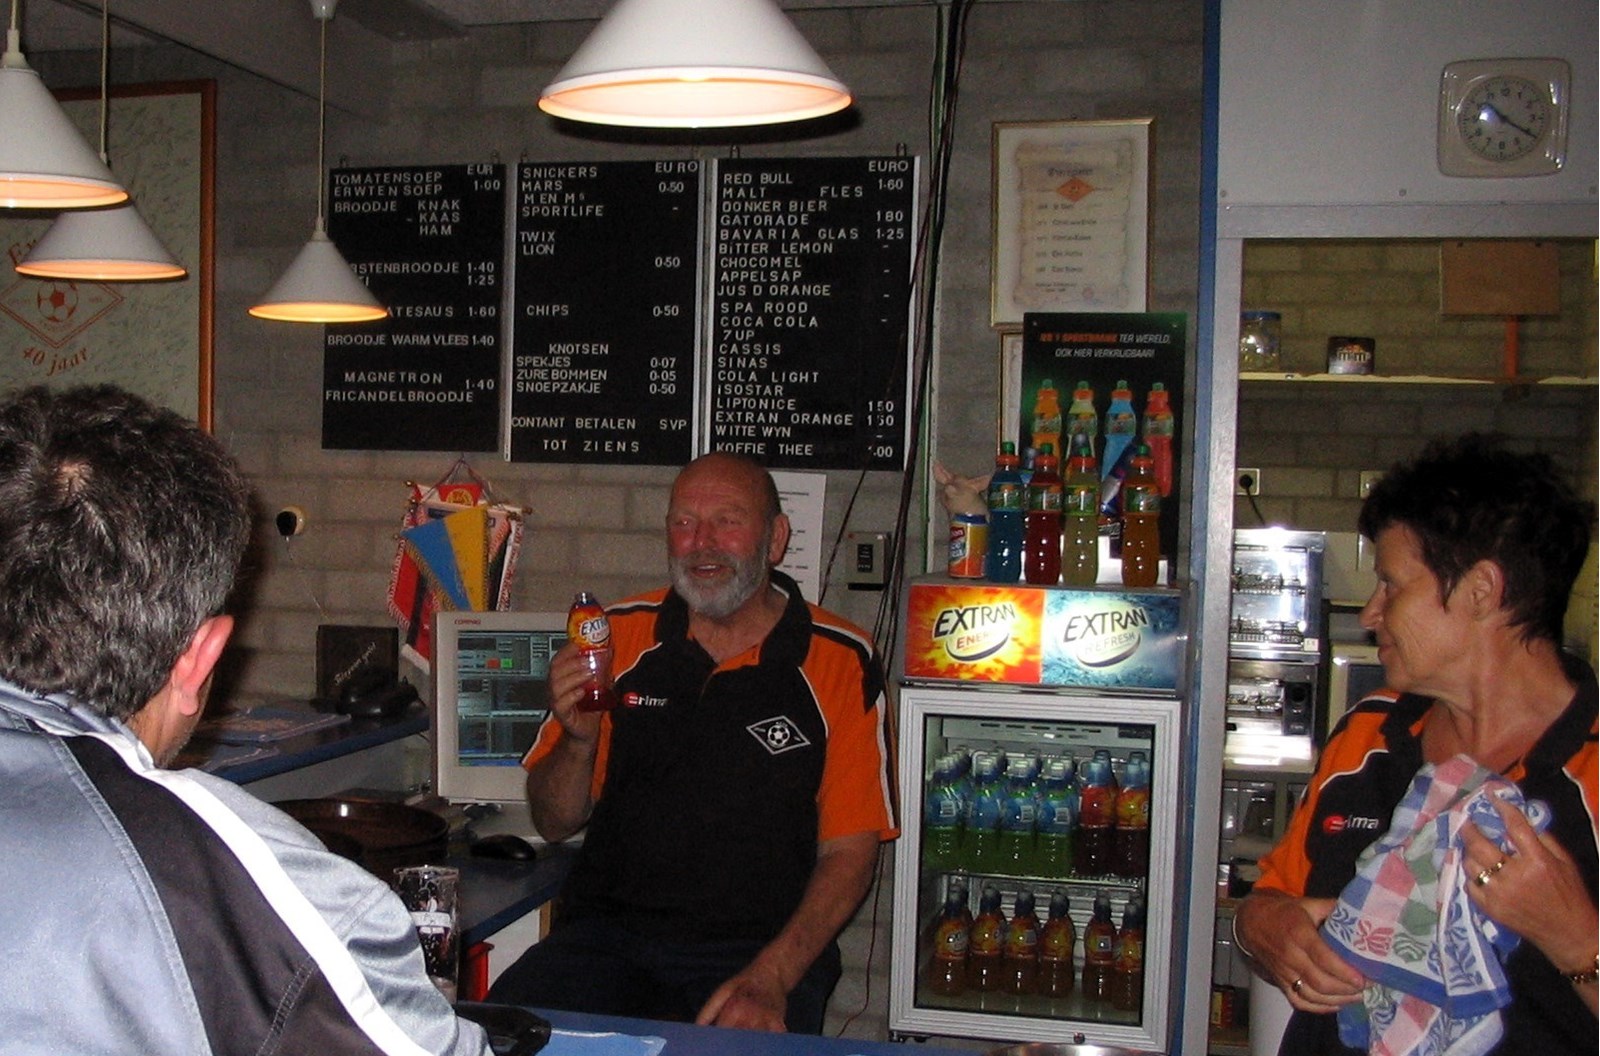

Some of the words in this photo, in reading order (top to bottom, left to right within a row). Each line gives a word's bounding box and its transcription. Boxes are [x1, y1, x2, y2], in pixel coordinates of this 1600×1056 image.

[467, 164, 493, 175] EUR
[655, 161, 698, 173] EURO
[868, 160, 909, 172] EURO
[334, 172, 442, 185] TOMATENSOEP
[523, 167, 597, 179] SNICKERS
[724, 173, 752, 184] RED
[760, 173, 793, 184] BULL
[522, 180, 563, 191] MARS
[723, 187, 766, 198] MALT
[820, 186, 863, 197] FLES
[334, 201, 397, 213] BROODJE
[417, 200, 460, 211] KNAK
[522, 205, 604, 217] SPORTLIFE
[722, 201, 781, 213] DONKER
[789, 200, 827, 212] BIER
[419, 212, 460, 223] KAAS
[720, 214, 809, 226] GATORADE
[419, 225, 452, 236] HAM
[520, 231, 555, 242] TWIX
[720, 228, 800, 240] BAVARIA
[818, 228, 859, 239] GLAS
[523, 244, 554, 255] LION
[781, 243, 833, 254] LEMON
[352, 262, 459, 274] RSTENBROODJE
[720, 257, 802, 268] CHOCOMEL
[720, 270, 801, 282] APPELSAP
[717, 285, 746, 296] JUS
[769, 285, 831, 296] ORANGE
[387, 306, 454, 317] ATESAUS
[526, 305, 569, 316] CHIPS
[721, 301, 753, 313] SPA
[764, 301, 808, 313] ROOD
[720, 316, 764, 327] COCA
[774, 316, 818, 327] COLA
[327, 334, 386, 346] BROODJE
[549, 343, 609, 355] KNOTSEN
[719, 343, 781, 355] CASSIS
[47, 348, 87, 376] jaar
[516, 356, 571, 367] SPEKJES
[717, 357, 768, 368] SINAS
[344, 372, 442, 384] MAGNETRON
[717, 371, 758, 382] COLA
[771, 372, 819, 383] LIGHT
[516, 382, 601, 394] SNOEPZAKJE
[325, 390, 473, 403] FRICANDELBROODJE
[511, 417, 565, 428] CONTANT
[575, 417, 636, 429] BETALEN
[659, 419, 687, 430] SVP
[715, 412, 779, 423] EXTRAN
[791, 414, 853, 426] ORANGE
[715, 425, 756, 437] WITTE
[543, 439, 567, 450] TOT
[583, 440, 640, 452] ZIENS
[716, 442, 766, 455] KOFFIE
[779, 444, 813, 456] THEE
[934, 603, 1016, 638] EXTRAN
[1063, 607, 1148, 643] EXTRAN
[956, 632, 989, 649] ENER
